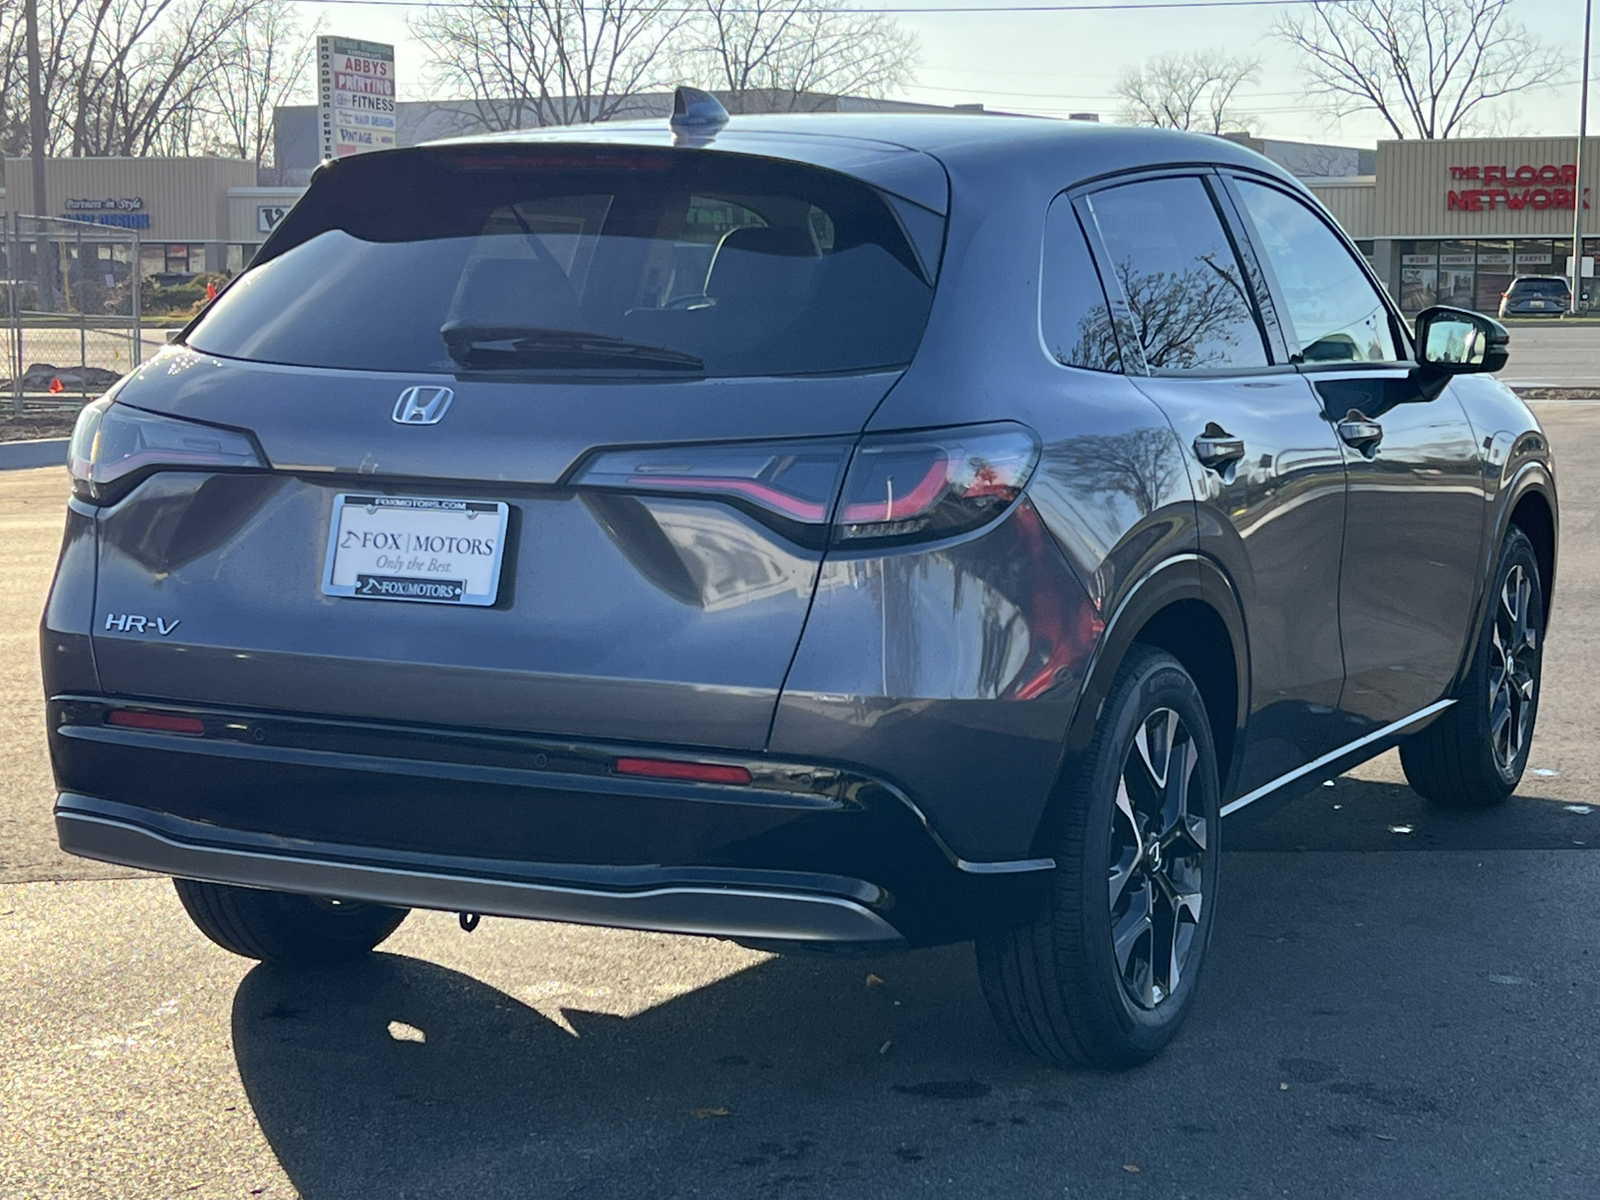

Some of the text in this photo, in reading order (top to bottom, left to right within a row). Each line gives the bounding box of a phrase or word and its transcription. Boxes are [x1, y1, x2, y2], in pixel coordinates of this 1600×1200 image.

[345, 57, 387, 76] ABBYS
[338, 74, 393, 95] PRINTING
[320, 38, 332, 159] BROADMOOR CENTER
[352, 94, 395, 112] FITNESS
[1449, 164, 1577, 187] THE FLOOR
[1519, 255, 1547, 263] CARPET
[375, 498, 467, 510] FOXMOTORS.COM
[361, 531, 495, 556] FOX MOTORS
[376, 555, 405, 574] Only
[406, 556, 425, 571] the
[105, 613, 181, 635] HR-V
